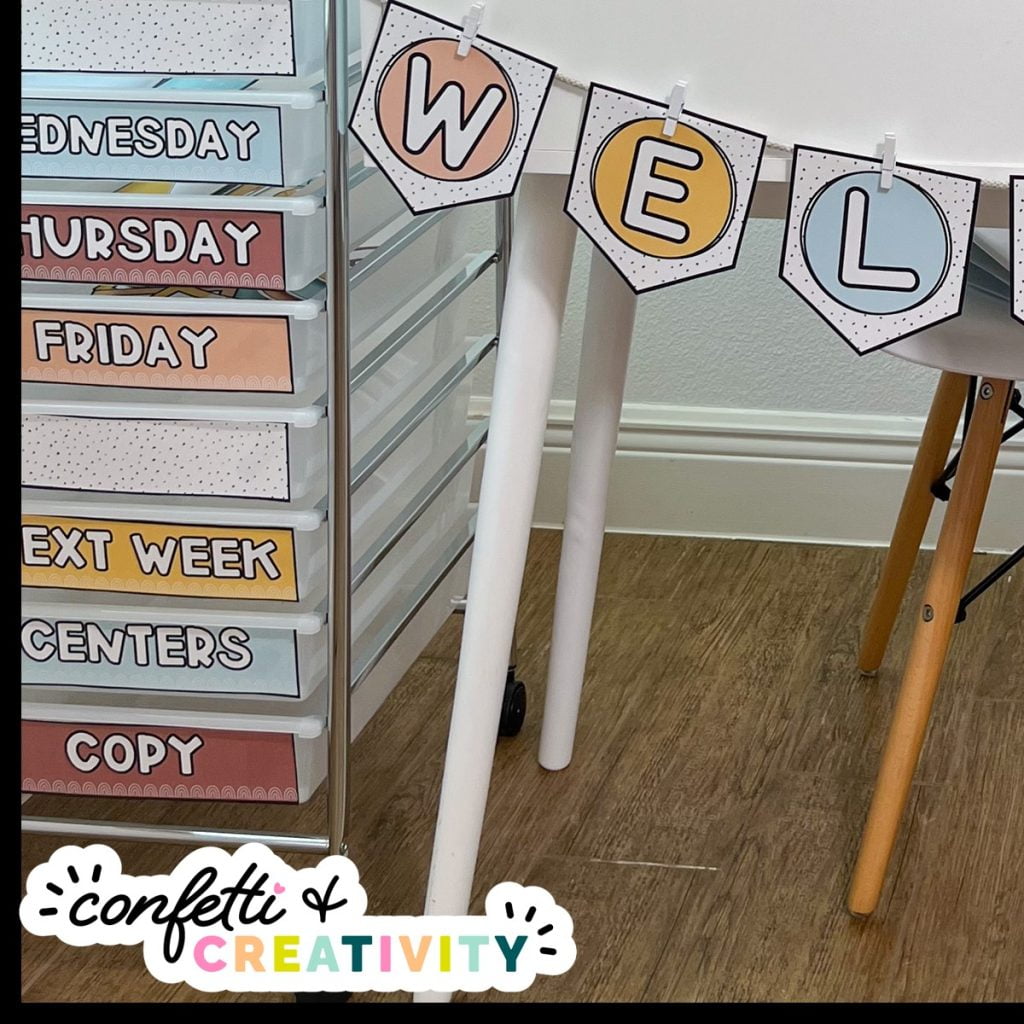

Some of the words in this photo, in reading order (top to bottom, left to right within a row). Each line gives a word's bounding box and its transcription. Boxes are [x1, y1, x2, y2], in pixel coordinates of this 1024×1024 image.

[21, 114, 259, 161] EDNESDAY
[21, 214, 260, 266] HURSDAY
[33, 320, 217, 368] FRIDAY
[21, 525, 113, 572] EXT
[130, 533, 281, 581] WEEK
[21, 618, 253, 670] CENTERS
[65, 730, 204, 776] COPY
